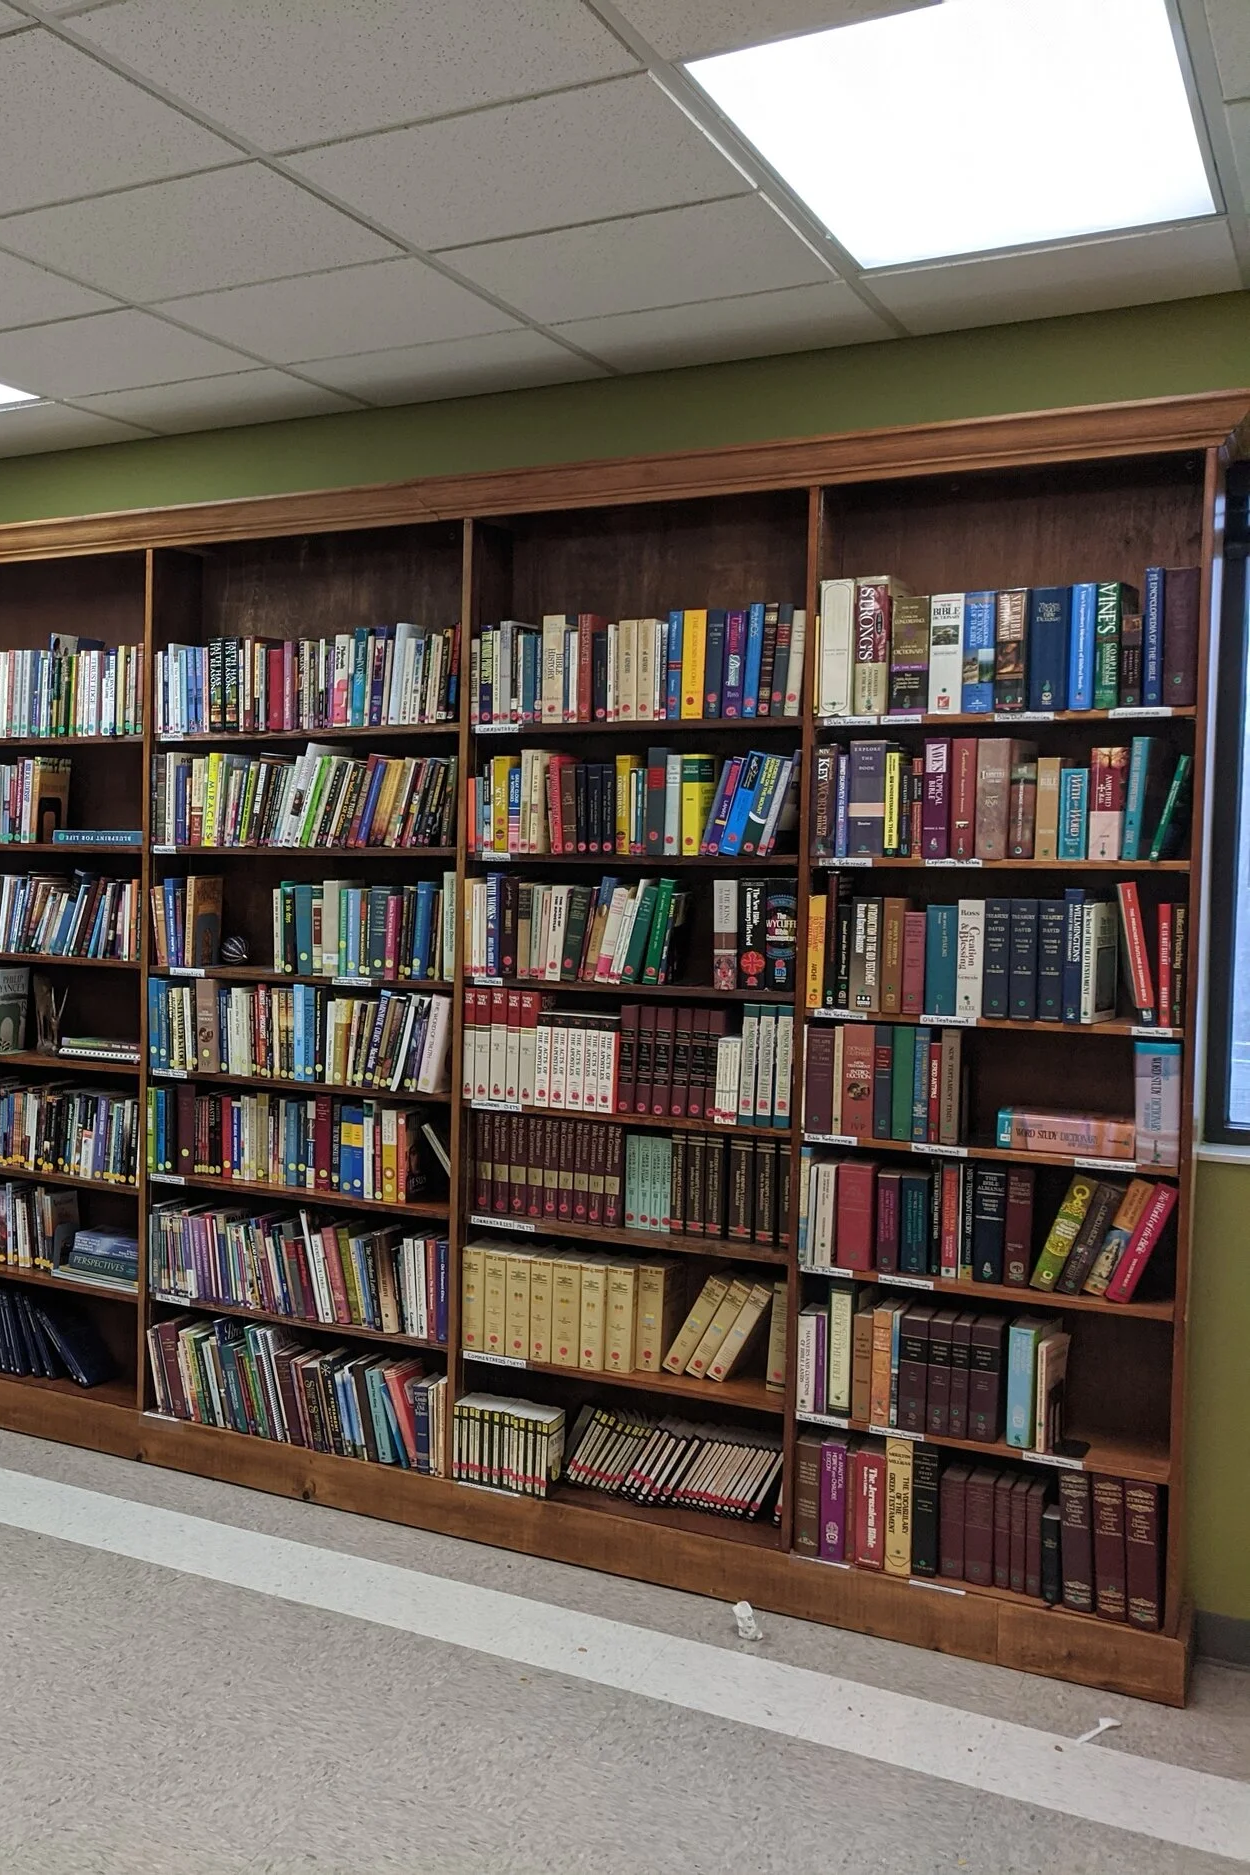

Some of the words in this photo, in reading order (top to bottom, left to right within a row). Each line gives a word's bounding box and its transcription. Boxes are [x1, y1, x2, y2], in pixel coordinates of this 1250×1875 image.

[932, 607, 960, 615] BIBLE
[1011, 595, 1021, 612] NEW
[1098, 583, 1117, 634] VINE'S
[1148, 582, 1157, 633] ENCYCLOPEDIA
[858, 587, 875, 661] STRONG'S
[998, 595, 1010, 640] DICTIONARY
[1011, 614, 1021, 639] BIBLE
[1148, 634, 1156, 644] OF
[547, 648, 556, 680] HISTORY
[555, 653, 563, 675] BIBLE
[1109, 642, 1117, 685] COMPLETE
[1148, 646, 1156, 660] THE
[818, 758, 829, 780] KEY
[931, 745, 945, 772] NAVE'S
[817, 782, 828, 814] WORD
[935, 774, 943, 805] TOPICAL
[1105, 774, 1113, 807] AMPLIFIED
[206, 780, 214, 837] MIRACLES
[962, 923, 969, 931] &
[1073, 904, 1081, 962] WILLMINGTON'S
[1176, 909, 1185, 933] Biblical
[958, 931, 968, 970] Blessing
[967, 926, 980, 967] Creation
[1173, 934, 1184, 969] Preaching
[1016, 1127, 1035, 1137] WORD
[1037, 1130, 1057, 1140] STUDY
[1060, 1133, 1097, 1144] DICTIONARY
[1161, 1190, 1170, 1200] The
[1149, 1202, 1166, 1221] World
[1145, 1220, 1155, 1229] of
[73, 1255, 124, 1271] PERSPECTIVES
[868, 1468, 878, 1483] The
[868, 1485, 878, 1526] Jerusalem
[896, 1492, 901, 1500] OF
[867, 1527, 876, 1548] Bible
